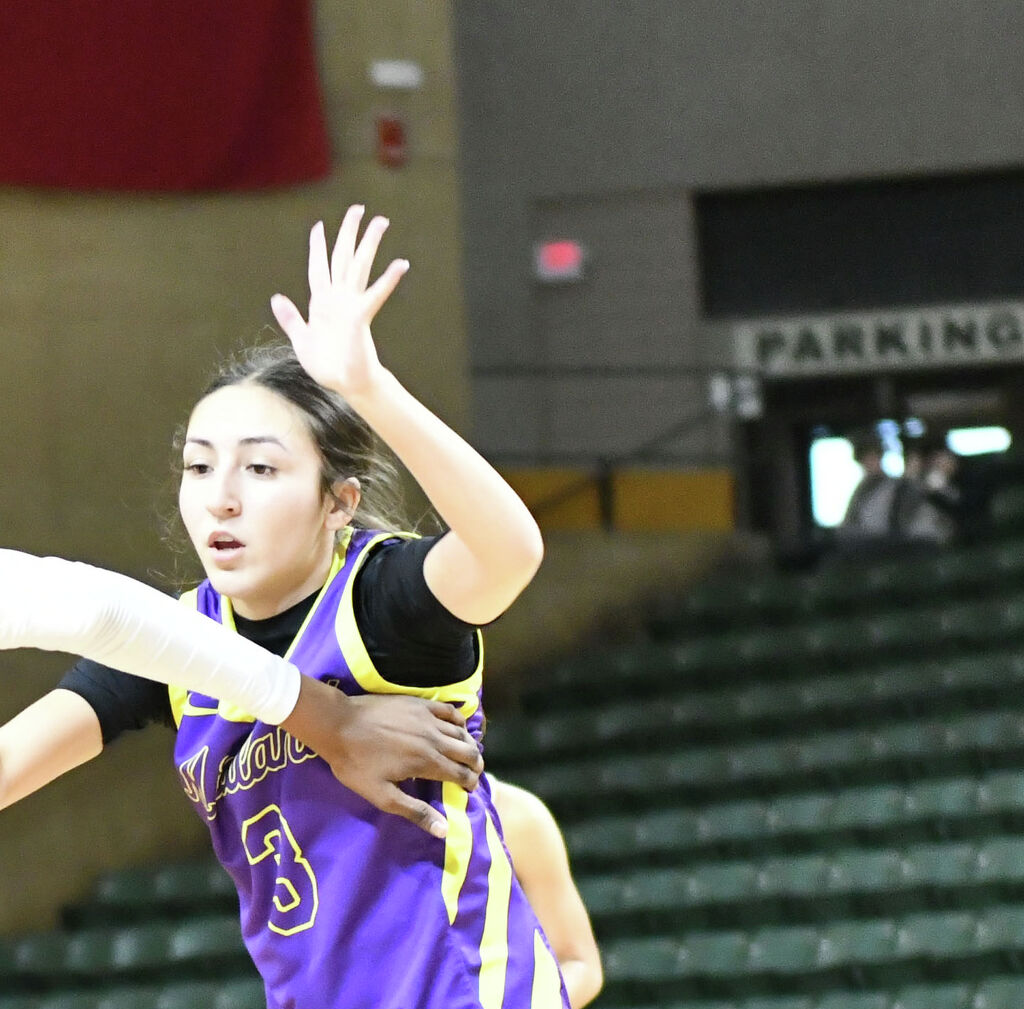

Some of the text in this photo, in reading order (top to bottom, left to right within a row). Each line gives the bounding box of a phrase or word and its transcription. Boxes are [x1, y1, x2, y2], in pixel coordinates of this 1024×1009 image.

[756, 312, 1023, 361] PARKING
[179, 712, 326, 820] Mdlan
[241, 803, 318, 936] 3
